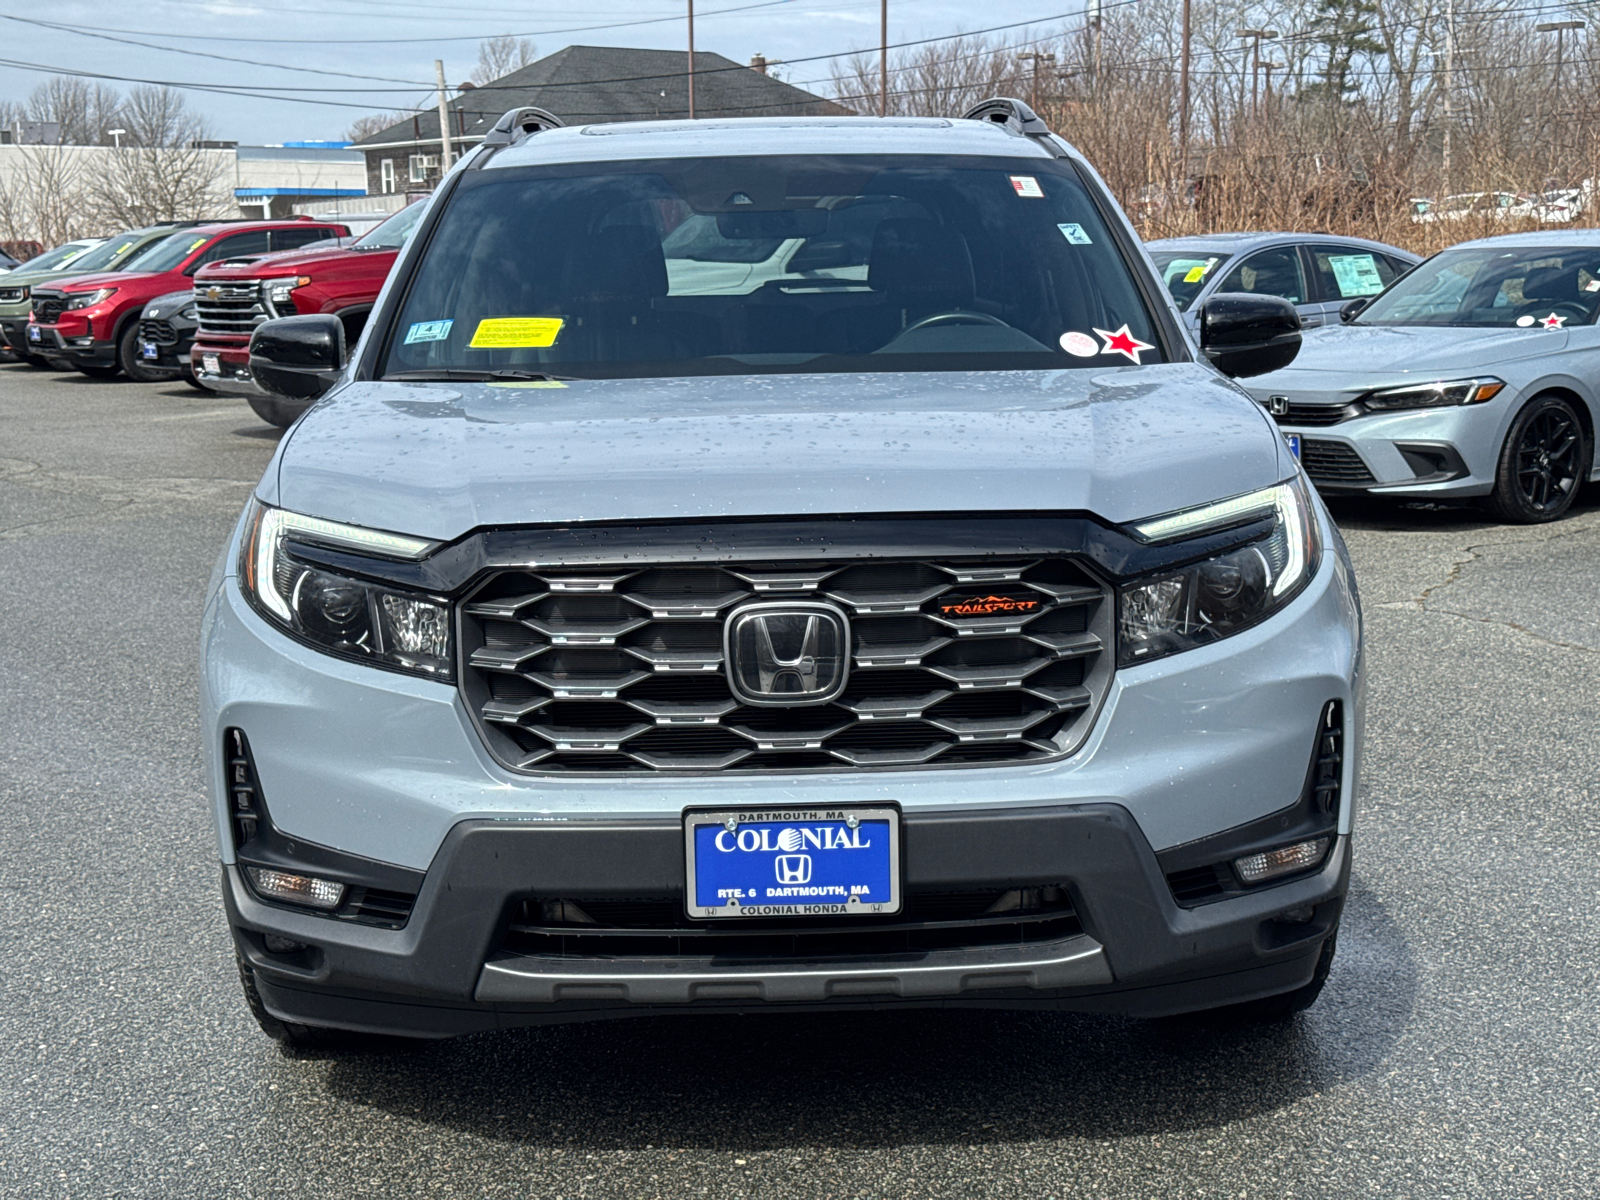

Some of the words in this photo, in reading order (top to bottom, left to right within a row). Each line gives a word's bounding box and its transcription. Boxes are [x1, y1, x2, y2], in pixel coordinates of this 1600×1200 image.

[424, 325, 433, 333] 4
[941, 601, 1038, 614] TRAILSPORT
[738, 812, 822, 822] DARTMOUTH,
[825, 811, 845, 820] MA
[715, 826, 871, 853] COLONIAL
[717, 888, 746, 898] RTE.
[748, 888, 757, 898] 6
[766, 885, 848, 897] DARTMOUTH,
[850, 885, 870, 895] MA
[740, 905, 801, 915] COLONIAL
[803, 904, 848, 915] HONDA
